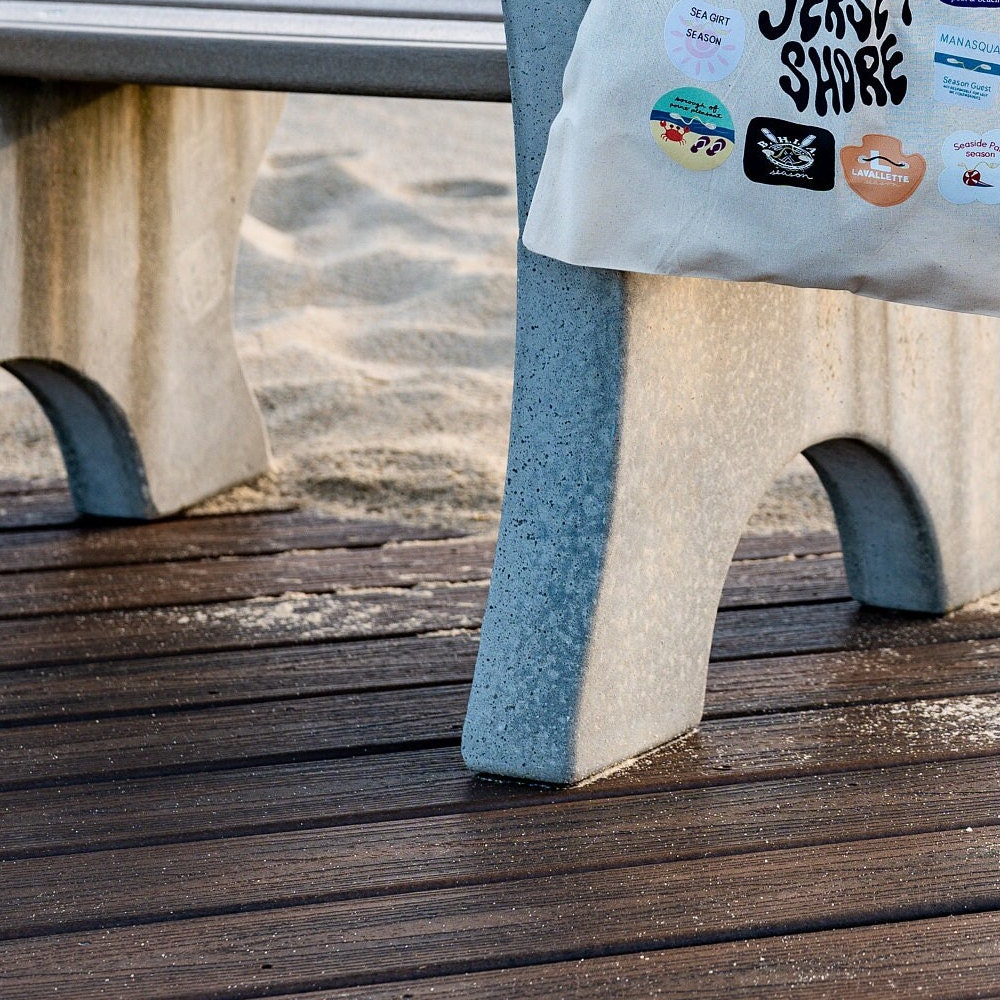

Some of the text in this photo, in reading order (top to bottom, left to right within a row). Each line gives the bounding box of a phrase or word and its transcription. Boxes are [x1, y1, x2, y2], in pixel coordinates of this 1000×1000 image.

[690, 7, 731, 26] SEA GIRT
[686, 28, 722, 46] SEASON
[779, 34, 907, 117] SHORE
[943, 76, 991, 92] Season Guest
[954, 139, 987, 151] Seaside
[851, 168, 909, 183] LAVALLETTE
